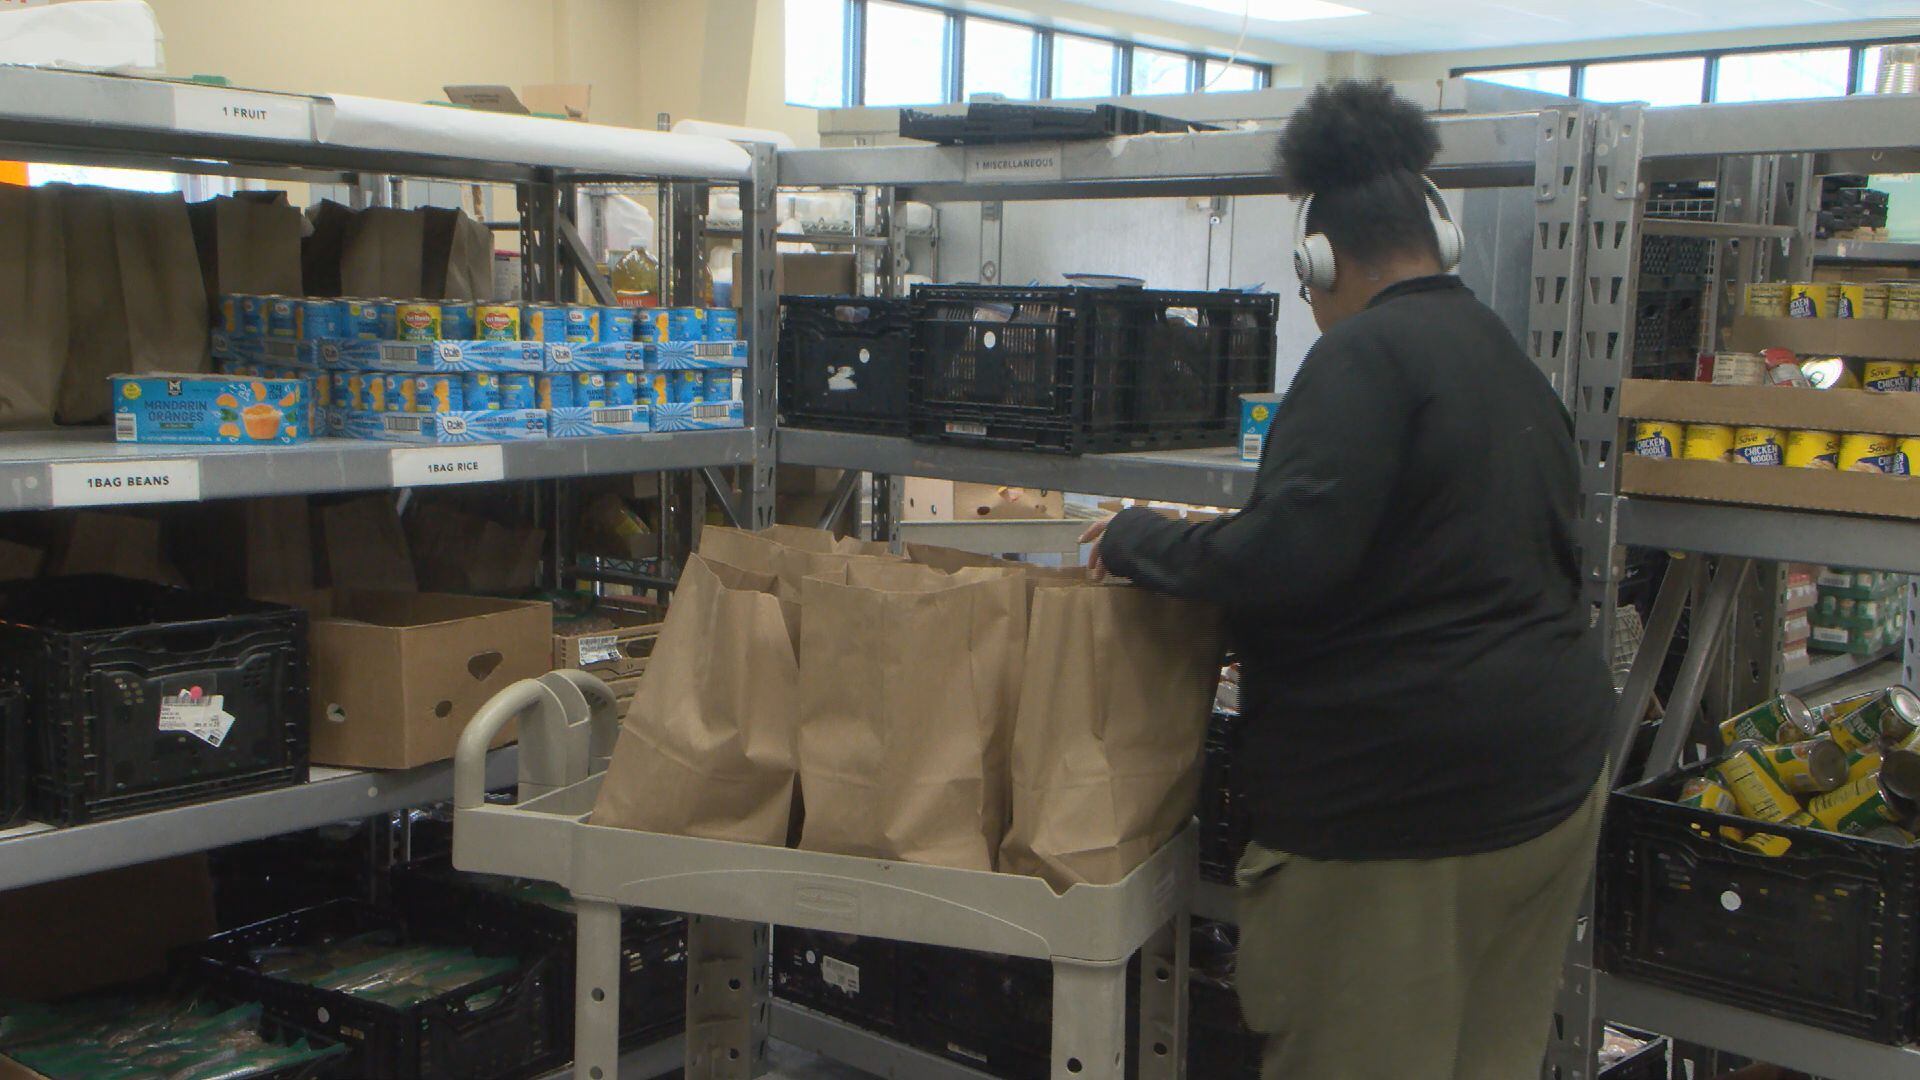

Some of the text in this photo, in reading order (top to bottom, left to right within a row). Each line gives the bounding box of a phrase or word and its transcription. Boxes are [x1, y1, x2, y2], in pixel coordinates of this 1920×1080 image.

[223, 107, 268, 120] 1 FRUIT
[983, 158, 1054, 170] MISCELLANEOUS
[443, 347, 460, 357] Dole
[555, 349, 569, 359] Dole
[144, 400, 208, 411] MANDARIN
[148, 411, 204, 422] ORANGES
[447, 420, 464, 430] Dole
[1636, 437, 1665, 450] CHICKEN
[1640, 446, 1666, 456] NOODLE
[1744, 444, 1778, 457] CHICKEN
[1750, 453, 1778, 464] NOODLE
[427, 461, 479, 473] 1BAG RICE
[87, 475, 170, 488] 1BAG BEANS
